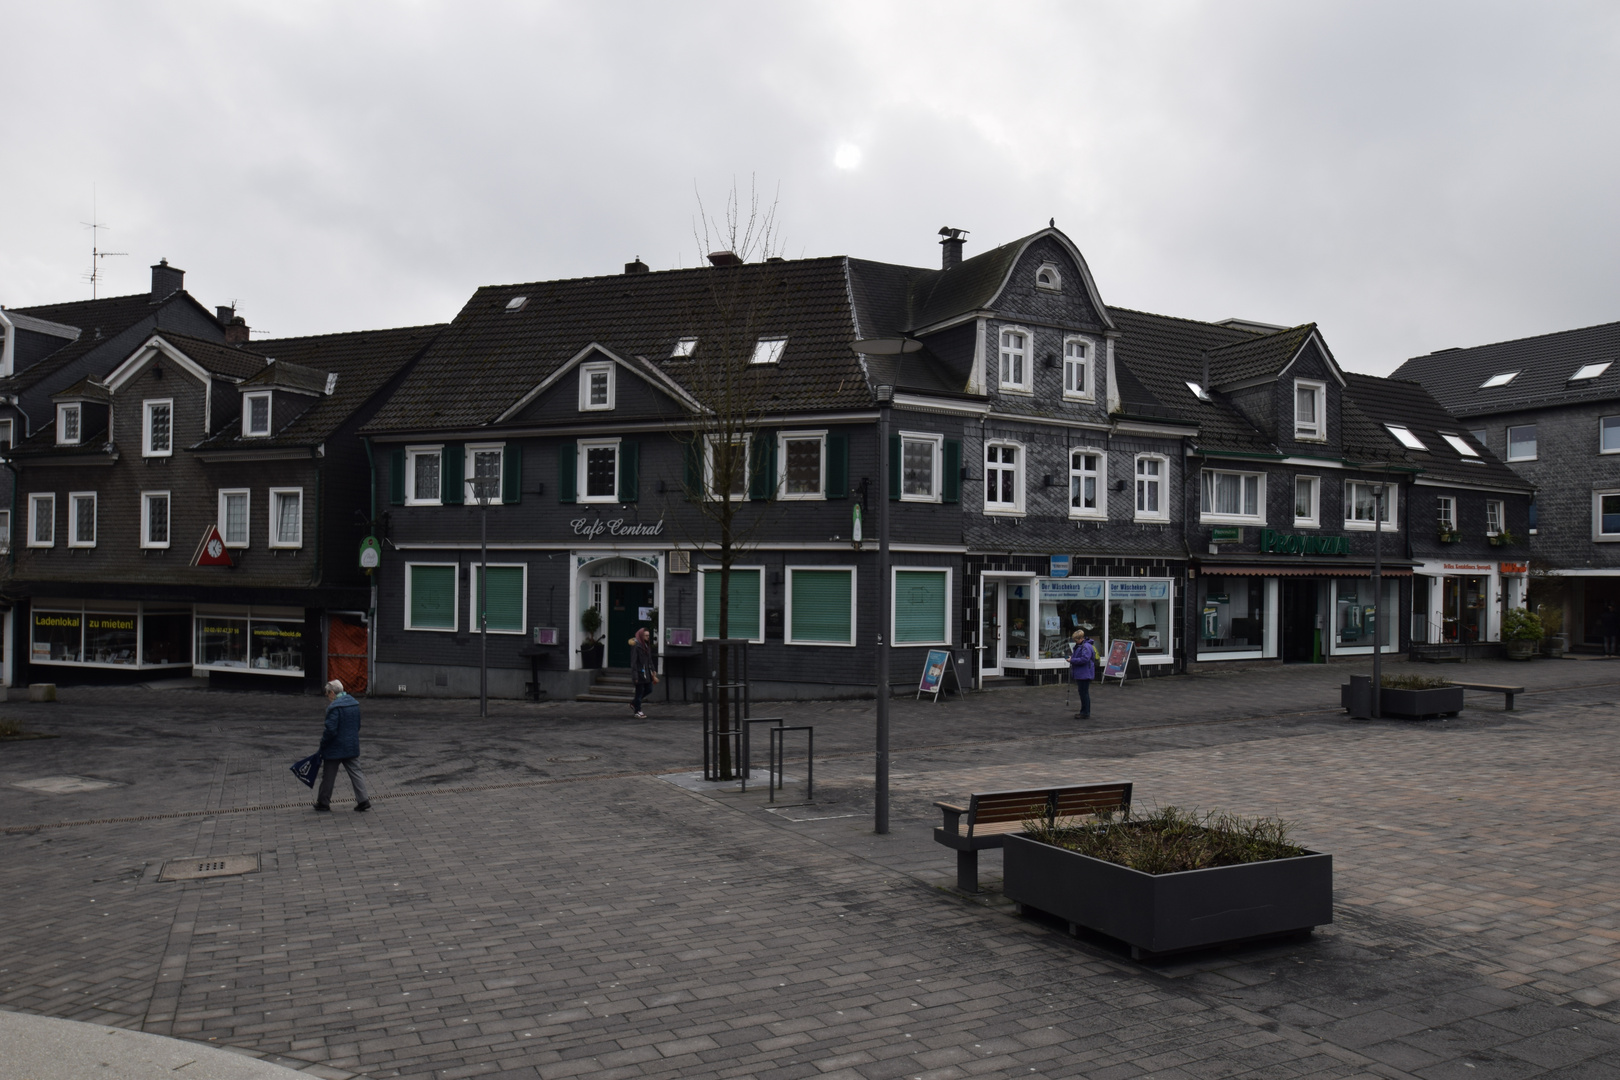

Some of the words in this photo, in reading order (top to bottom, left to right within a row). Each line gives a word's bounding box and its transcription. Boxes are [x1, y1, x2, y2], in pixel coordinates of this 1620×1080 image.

[570, 517, 606, 541] Café
[607, 518, 663, 536] Central
[1262, 529, 1352, 554] PROVINZIAL
[1014, 585, 1023, 598] 4
[35, 616, 80, 627] Ladenlokal
[89, 620, 99, 628] zu
[101, 618, 133, 629] mieten!
